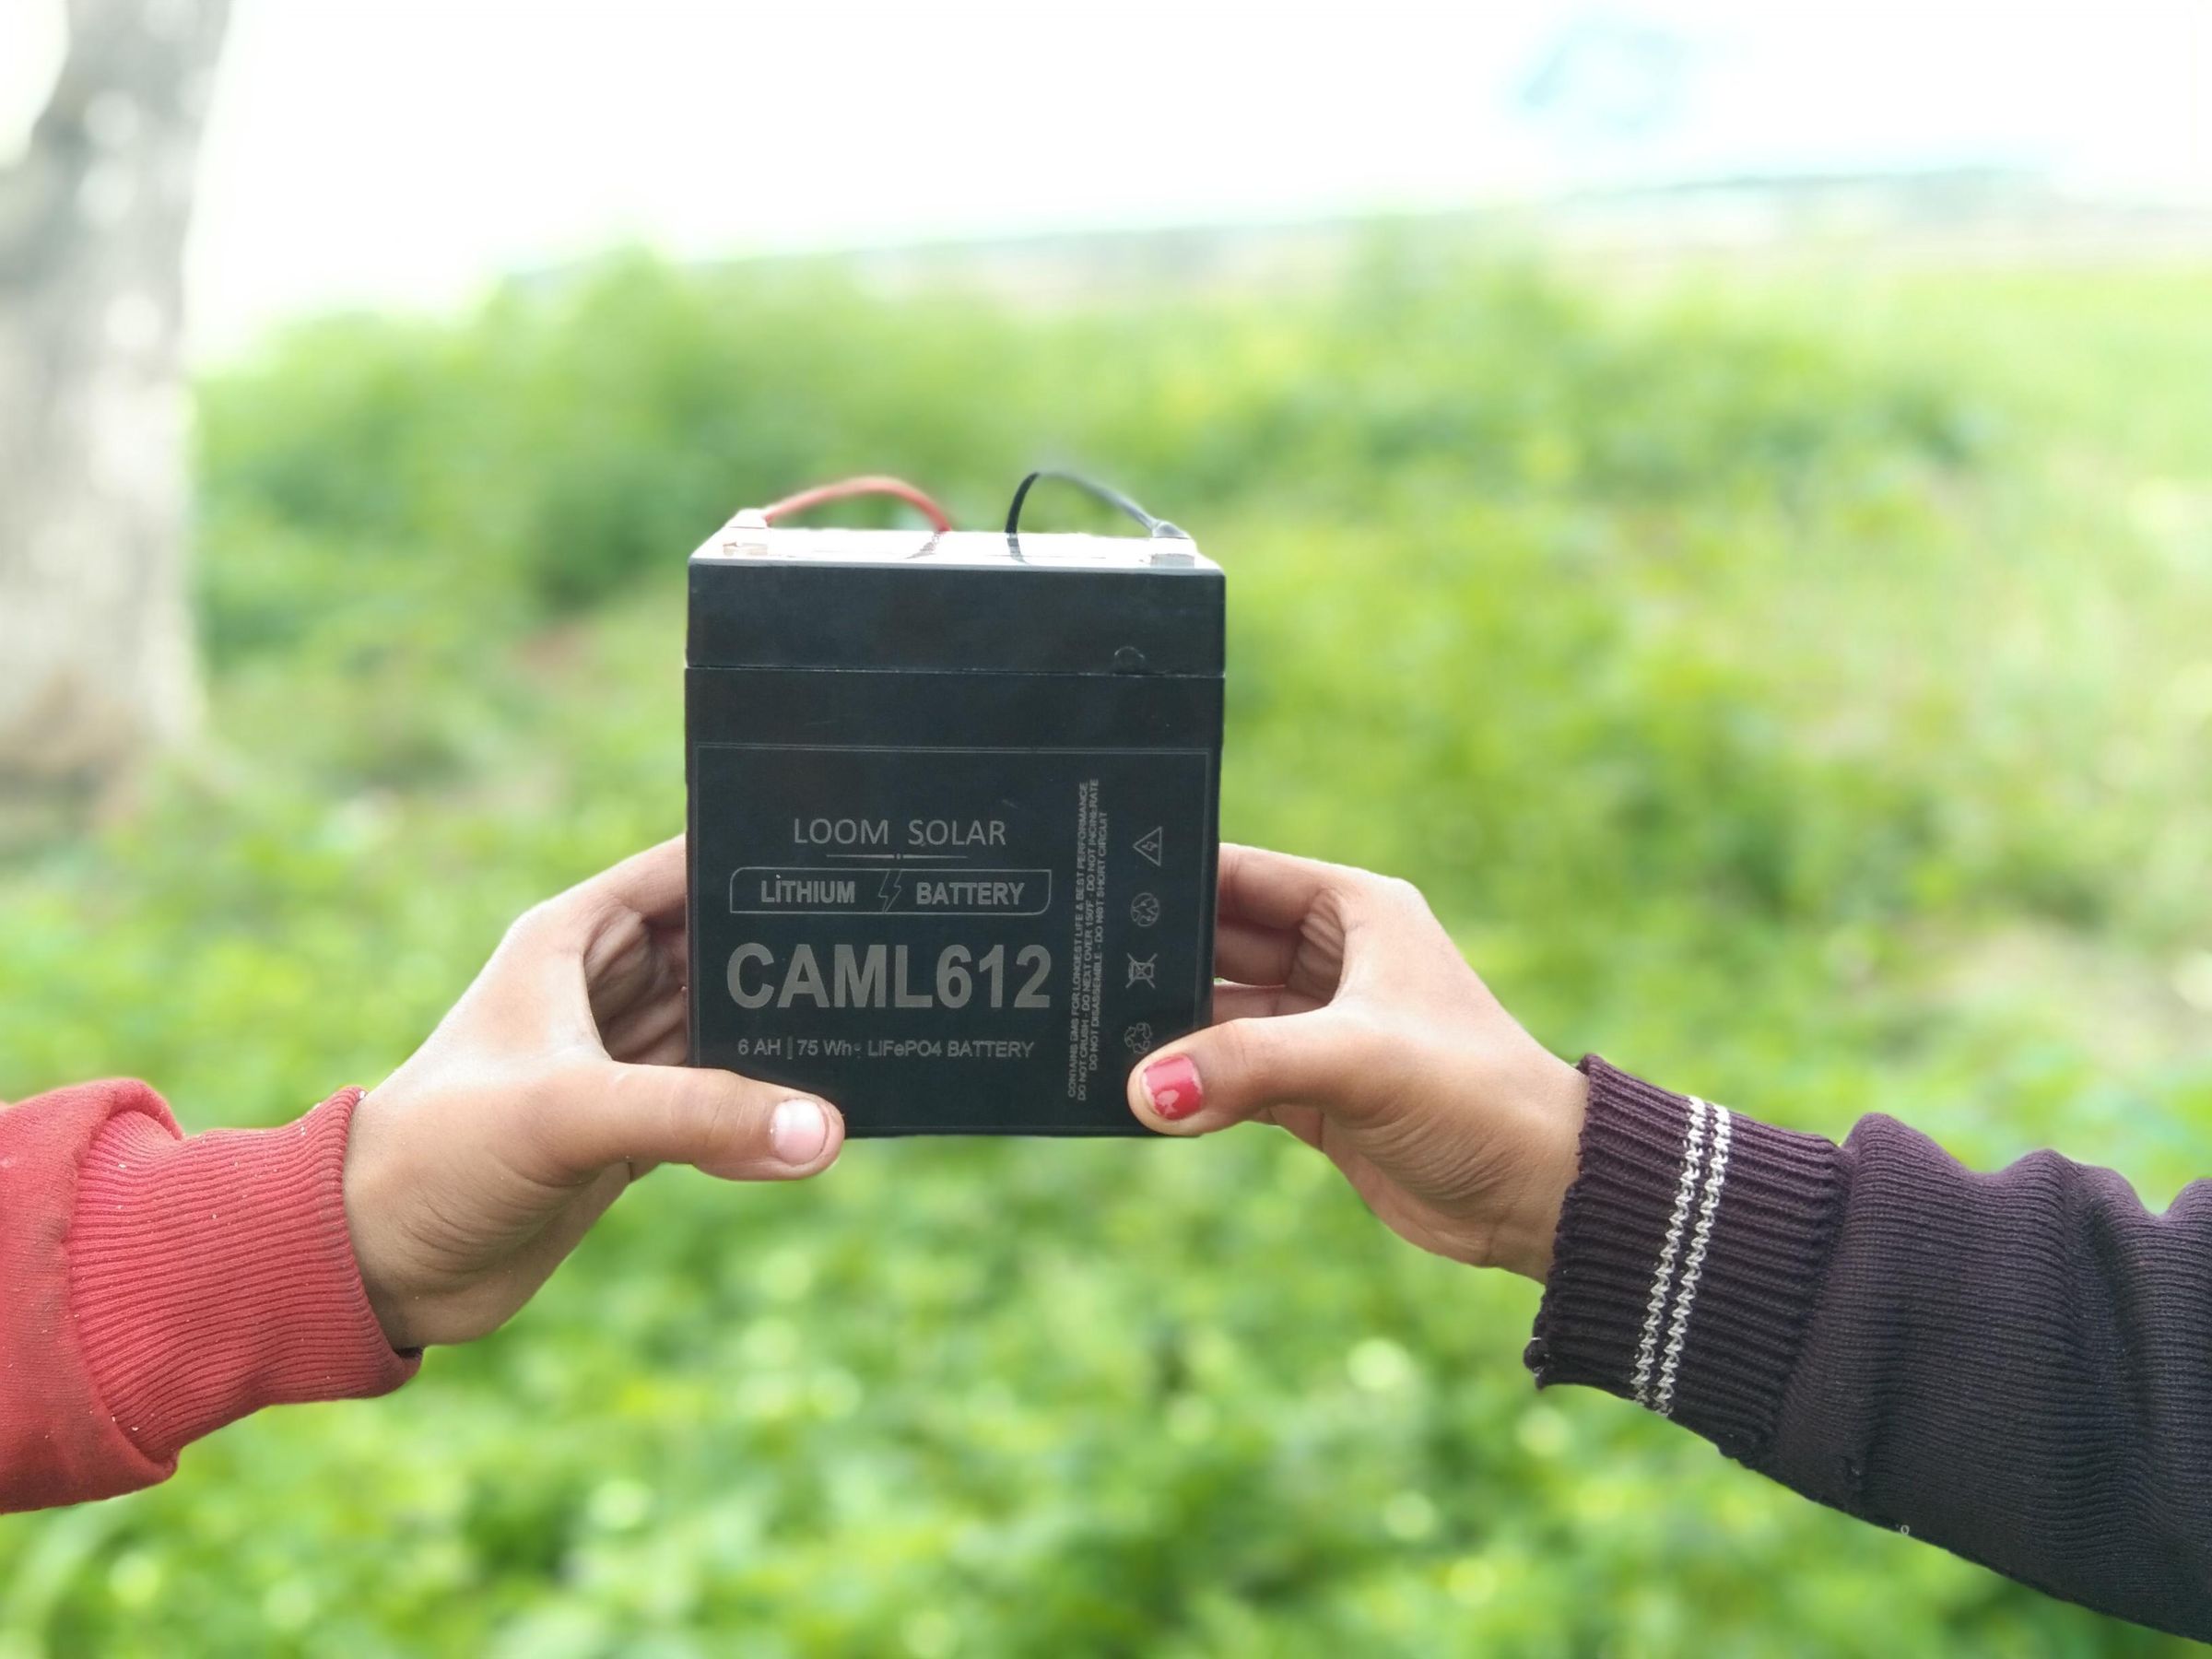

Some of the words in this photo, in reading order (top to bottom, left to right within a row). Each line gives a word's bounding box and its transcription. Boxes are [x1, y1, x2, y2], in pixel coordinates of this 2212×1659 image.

[1087, 778, 1099, 845] INCINERATE
[794, 818, 889, 845] LOOM
[908, 819, 1006, 846] SOLAR
[1077, 782, 1088, 869] PERFORMANCE
[1098, 812, 1108, 857] CIRCUIT
[1087, 848, 1096, 872] NOT
[1076, 872, 1084, 900] BEST
[1086, 874, 1095, 891] DO
[1096, 859, 1106, 899] SHORT
[915, 882, 1025, 906] BATTERY
[1095, 900, 1104, 924] NOT
[1074, 913, 1083, 936] LIFE
[1094, 925, 1103, 943] DO
[1083, 928, 1092, 961] OVER
[726, 942, 1052, 1008] CAML612
[1072, 941, 1082, 991] LONGEST
[1090, 952, 1102, 1027] DISASSEMBLE
[1071, 993, 1079, 1016] FOR
[1081, 994, 1089, 1011] DO
[738, 1039, 748, 1055] 6
[753, 1040, 781, 1056] AH
[797, 1040, 818, 1056] 75
[947, 1041, 1035, 1058] BATTERY
[1079, 1018, 1089, 1058] CRUSH
[1090, 1029, 1099, 1052] NOT
[1067, 1044, 1077, 1098] CONTAINS
[1078, 1060, 1088, 1083] NOT
[1089, 1053, 1098, 1070] DO
[1078, 1084, 1087, 1100] DO
